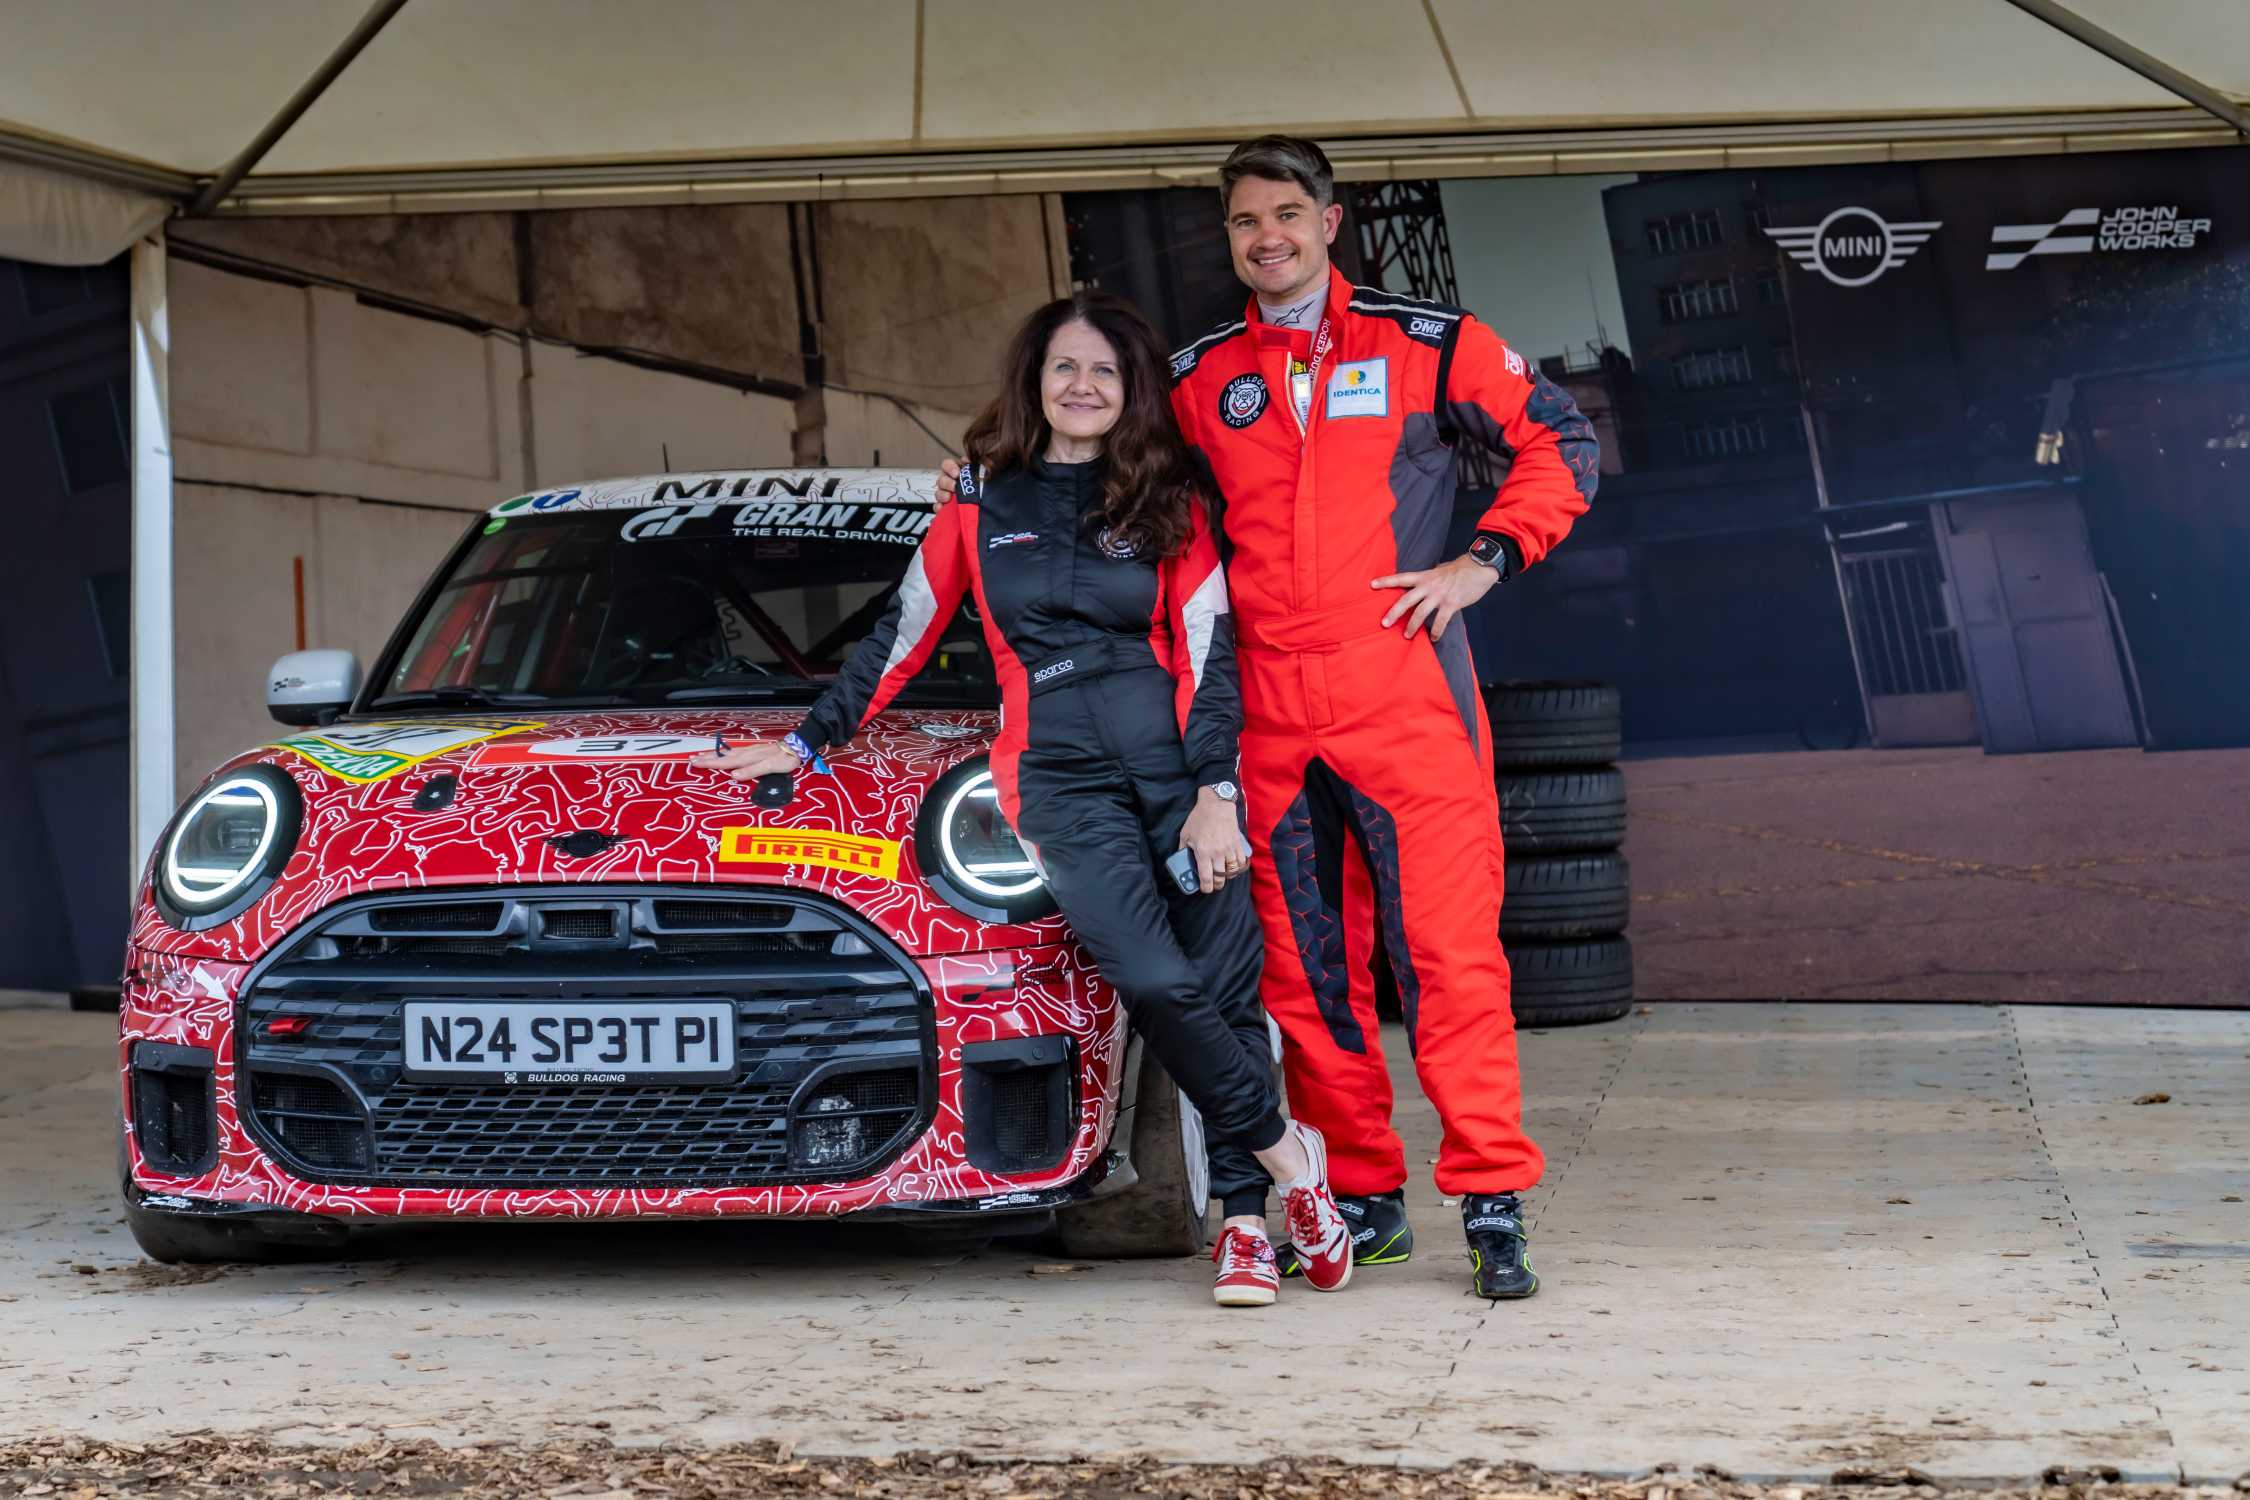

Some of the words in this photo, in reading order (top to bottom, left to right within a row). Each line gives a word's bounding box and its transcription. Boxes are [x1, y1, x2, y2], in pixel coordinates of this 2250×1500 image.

[2102, 206, 2178, 222] JOHN
[2100, 219, 2212, 236] COOPER
[1824, 236, 1881, 258] MINI
[2099, 233, 2196, 251] WORKS
[1315, 318, 1331, 353] ROGER
[1410, 320, 1445, 334] OMP
[1228, 376, 1267, 392] BULLDOG
[1333, 387, 1381, 398] IDENTICA
[1225, 411, 1260, 426] RACING
[961, 464, 975, 494] parco
[652, 478, 841, 501] MINI
[732, 503, 859, 527] GRAN
[732, 528, 771, 537] THE
[777, 528, 831, 538] REAL
[835, 529, 919, 546] DRIVING
[575, 739, 682, 752] 37
[291, 744, 399, 777] DEKRA
[735, 834, 884, 869] PIRELLI
[421, 1016, 517, 1063] N24
[530, 1016, 660, 1064] SP3T
[528, 1073, 579, 1082] BULLDOG
[583, 1073, 626, 1082] RACING
